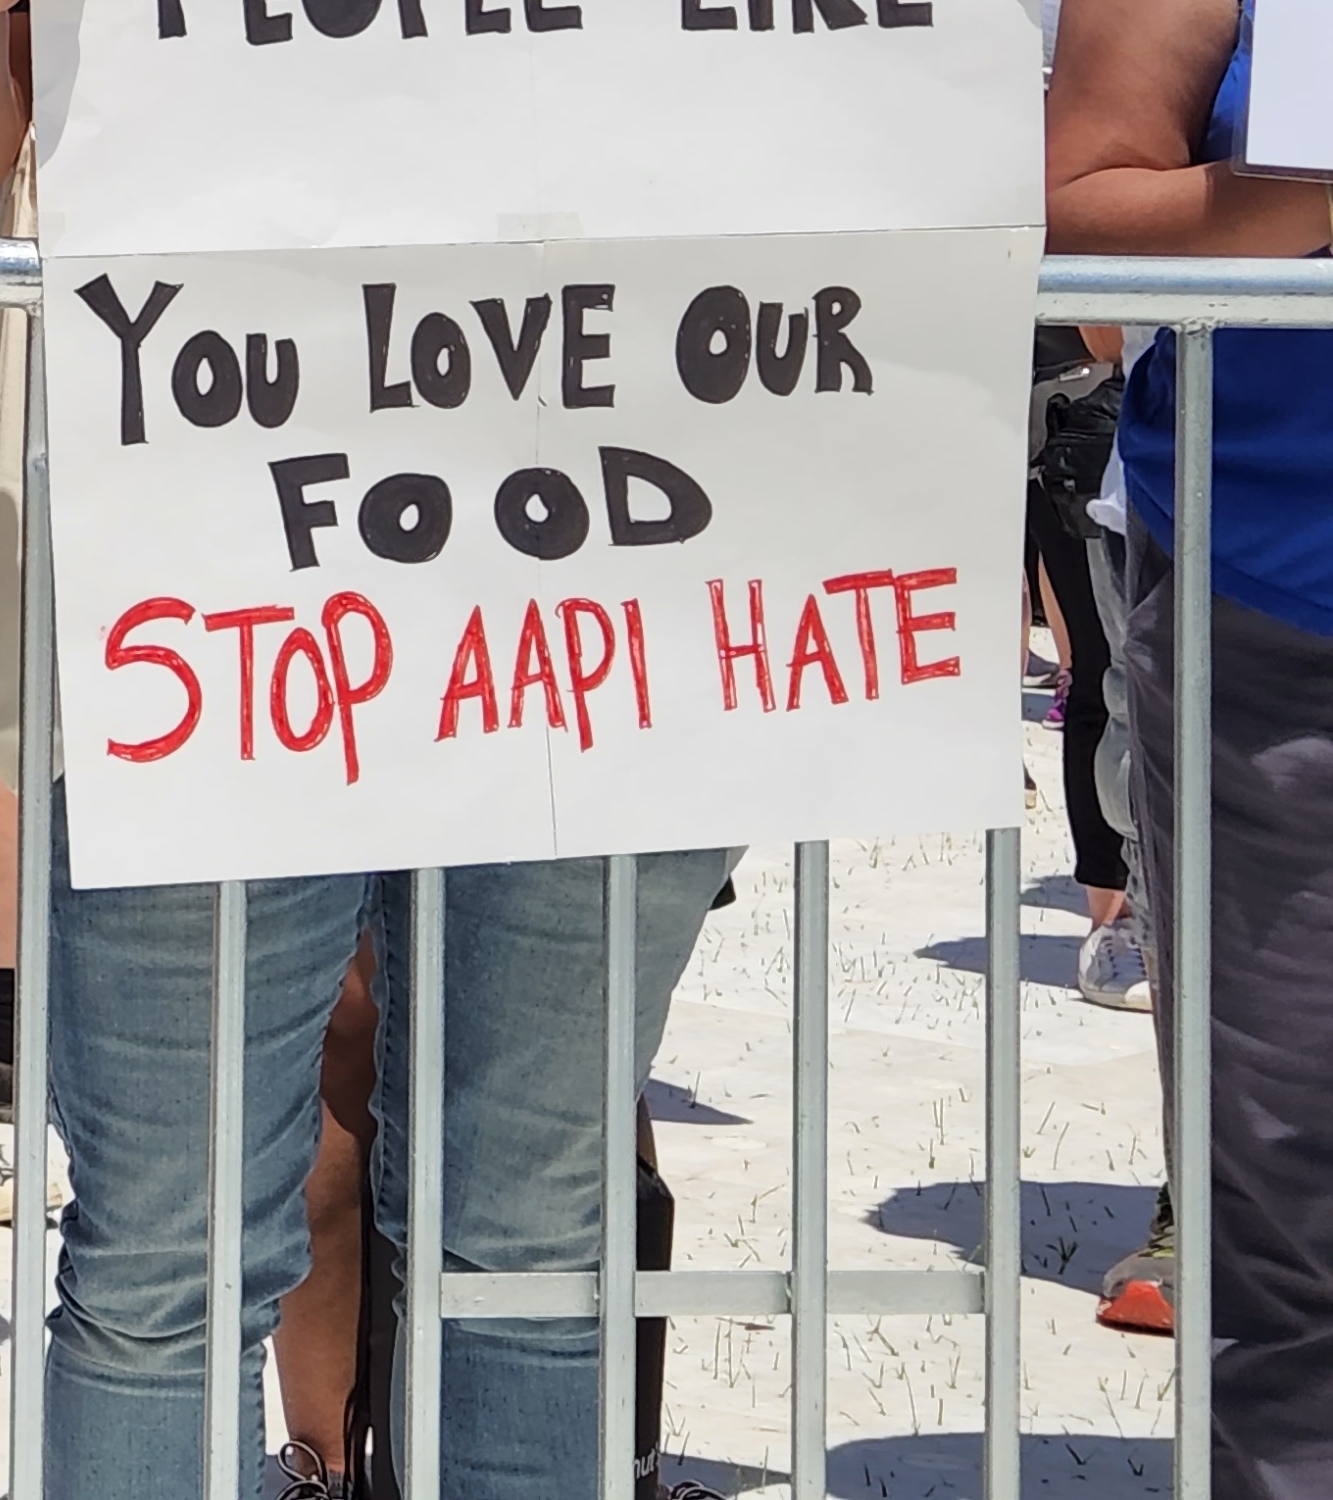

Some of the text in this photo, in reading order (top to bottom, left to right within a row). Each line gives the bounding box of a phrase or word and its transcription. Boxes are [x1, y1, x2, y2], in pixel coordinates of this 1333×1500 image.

[361, 282, 616, 413] LOVE
[675, 285, 873, 405] OUR
[268, 446, 714, 572] FOOD
[104, 567, 962, 785] STOP AAPI HATE
